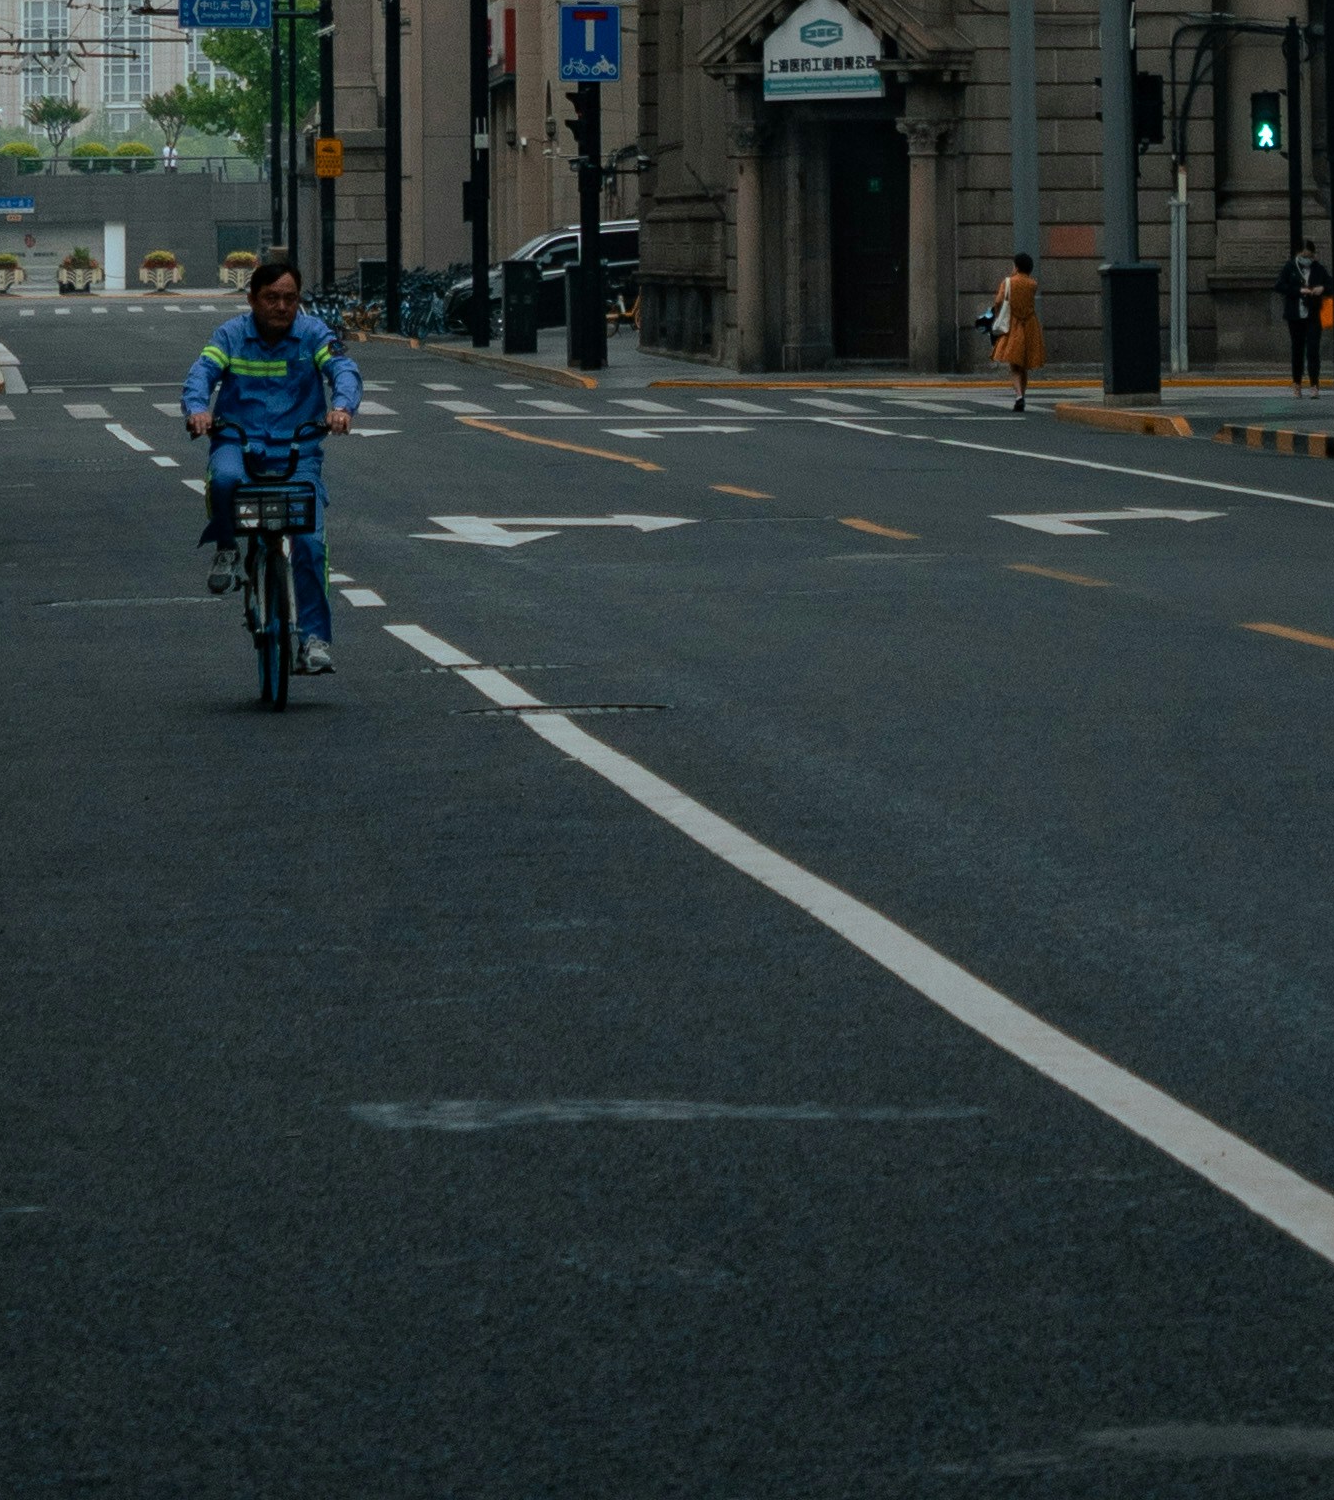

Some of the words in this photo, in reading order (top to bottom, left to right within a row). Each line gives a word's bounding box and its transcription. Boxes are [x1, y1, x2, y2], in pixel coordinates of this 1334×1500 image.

[768, 55, 877, 74] 上海医药工业有限公司
